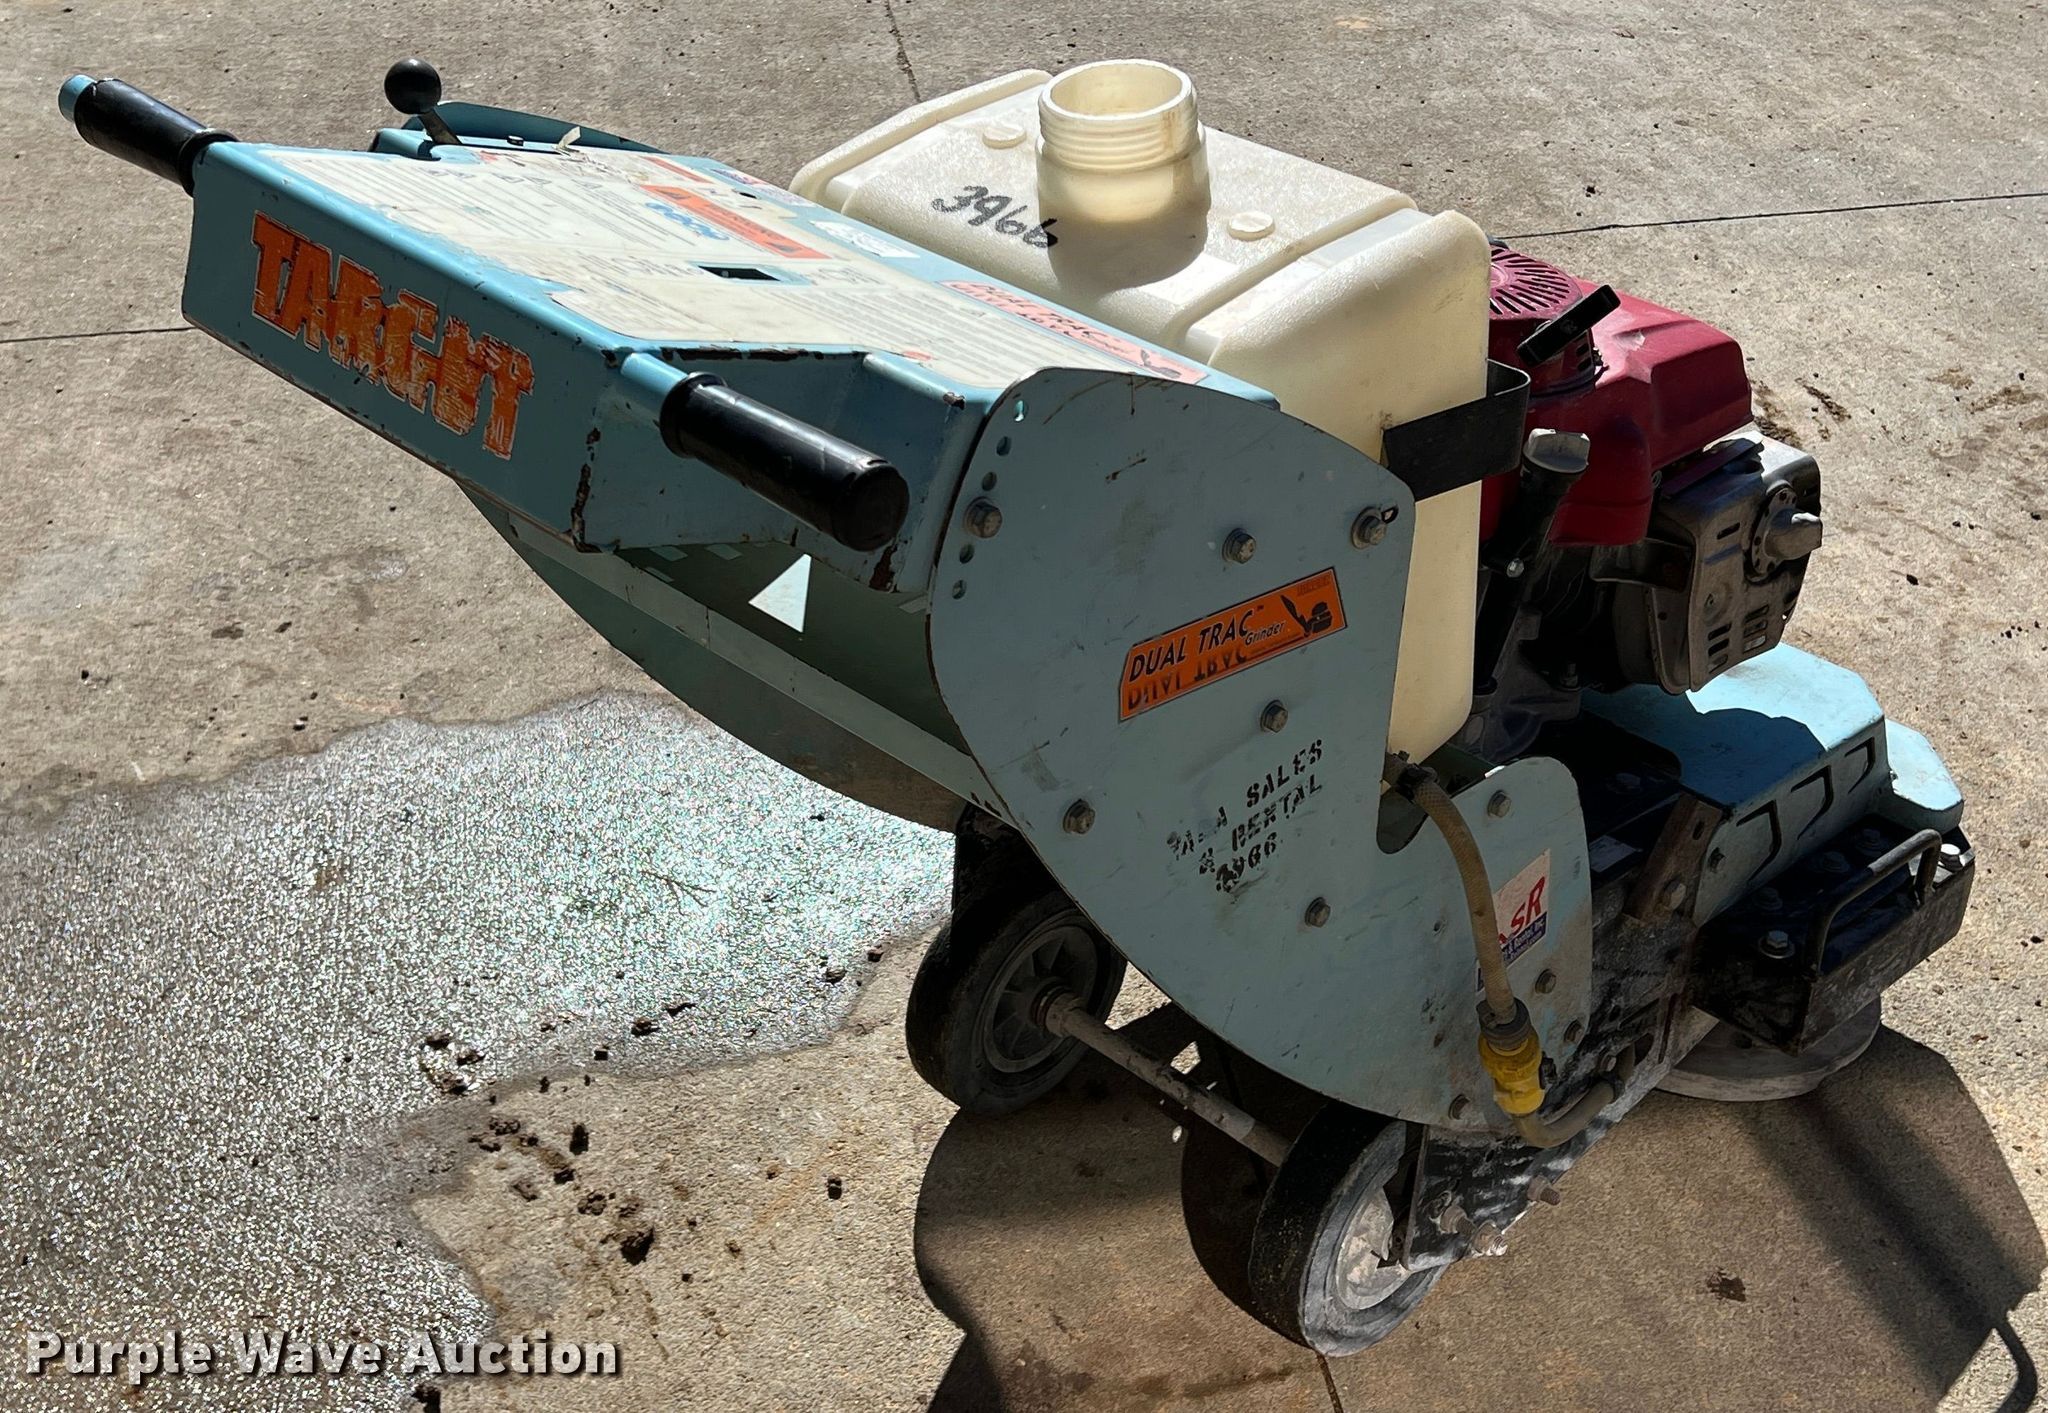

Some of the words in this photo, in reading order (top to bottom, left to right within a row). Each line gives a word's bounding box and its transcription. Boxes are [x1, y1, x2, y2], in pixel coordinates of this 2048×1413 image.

[931, 185, 1059, 249] 3966
[1129, 636, 1187, 682] DUAL
[1199, 609, 1254, 654] TRAC
[1244, 619, 1287, 646] Grinder
[1247, 739, 1322, 808] SALES
